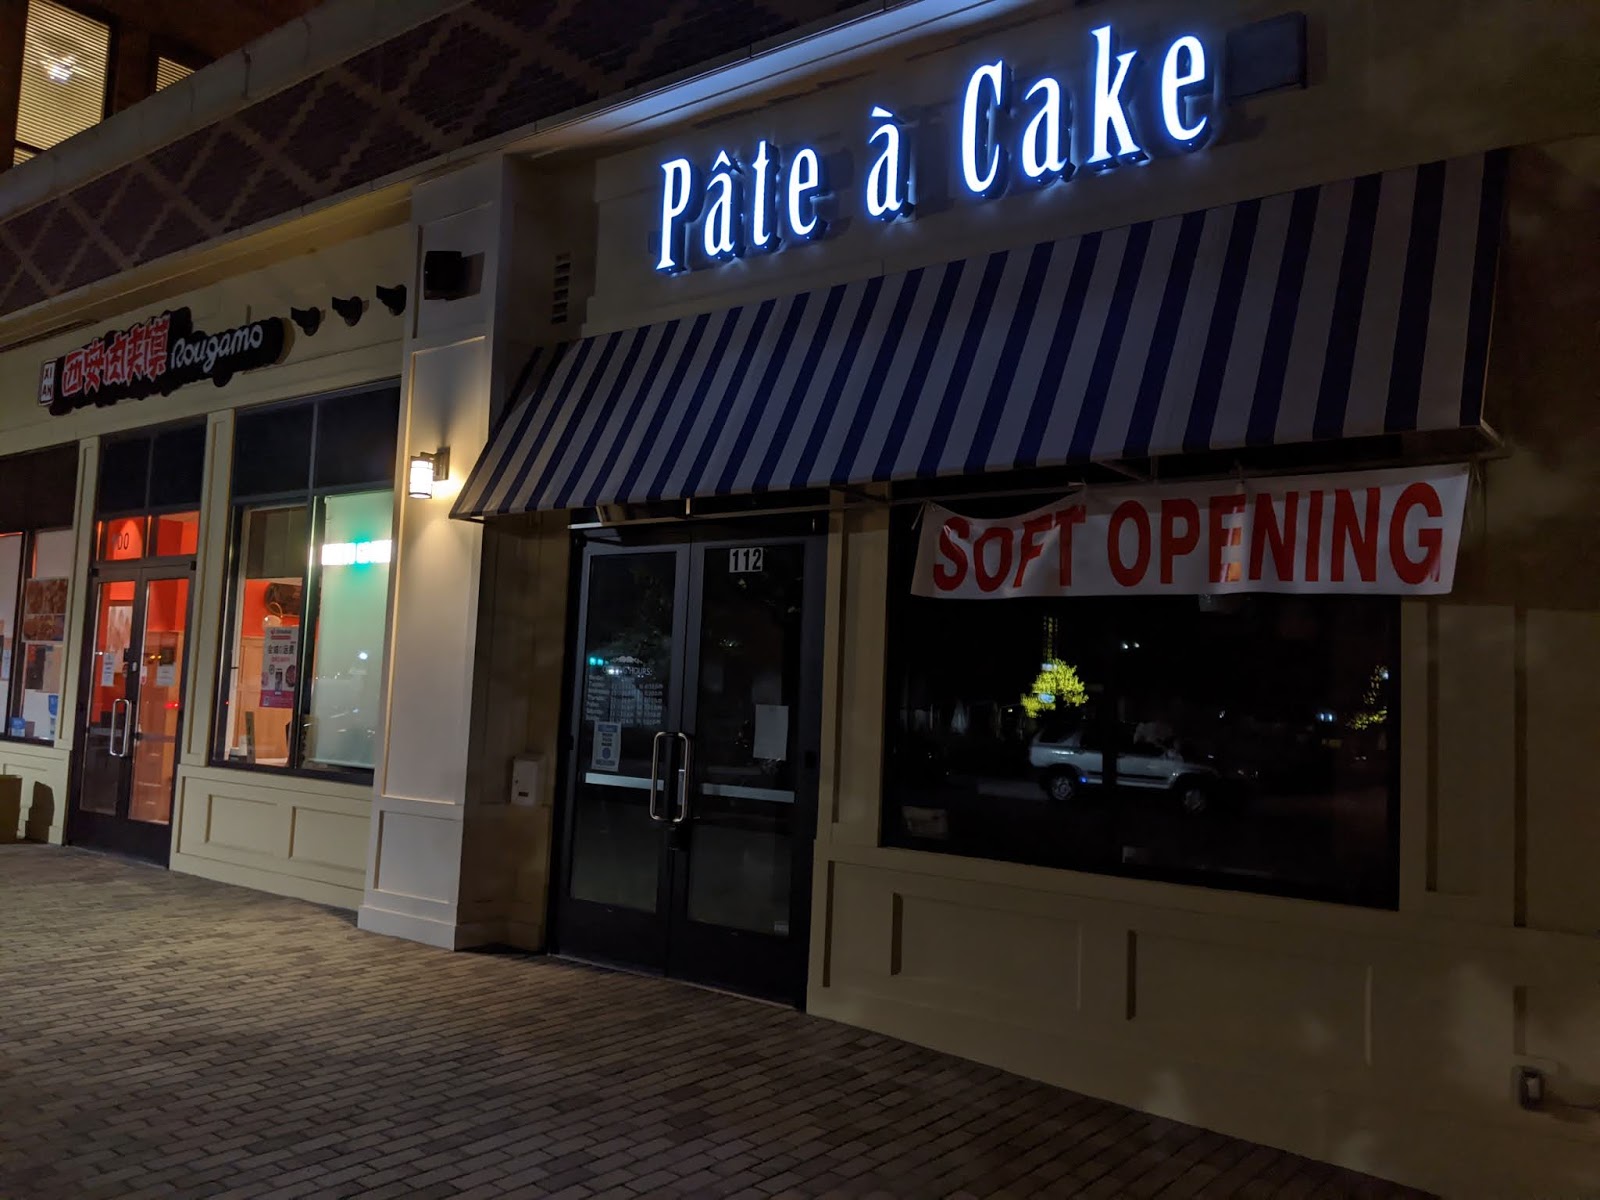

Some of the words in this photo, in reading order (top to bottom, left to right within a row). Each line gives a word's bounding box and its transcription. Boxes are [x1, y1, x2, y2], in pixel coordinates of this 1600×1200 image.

[656, 140, 820, 271] Pâte
[866, 106, 904, 219] à
[961, 24, 1208, 194] Cake
[170, 324, 264, 374] Rougamo
[731, 548, 762, 572] 112
[932, 504, 1087, 592] SOFT
[1107, 482, 1444, 588] OPENING
